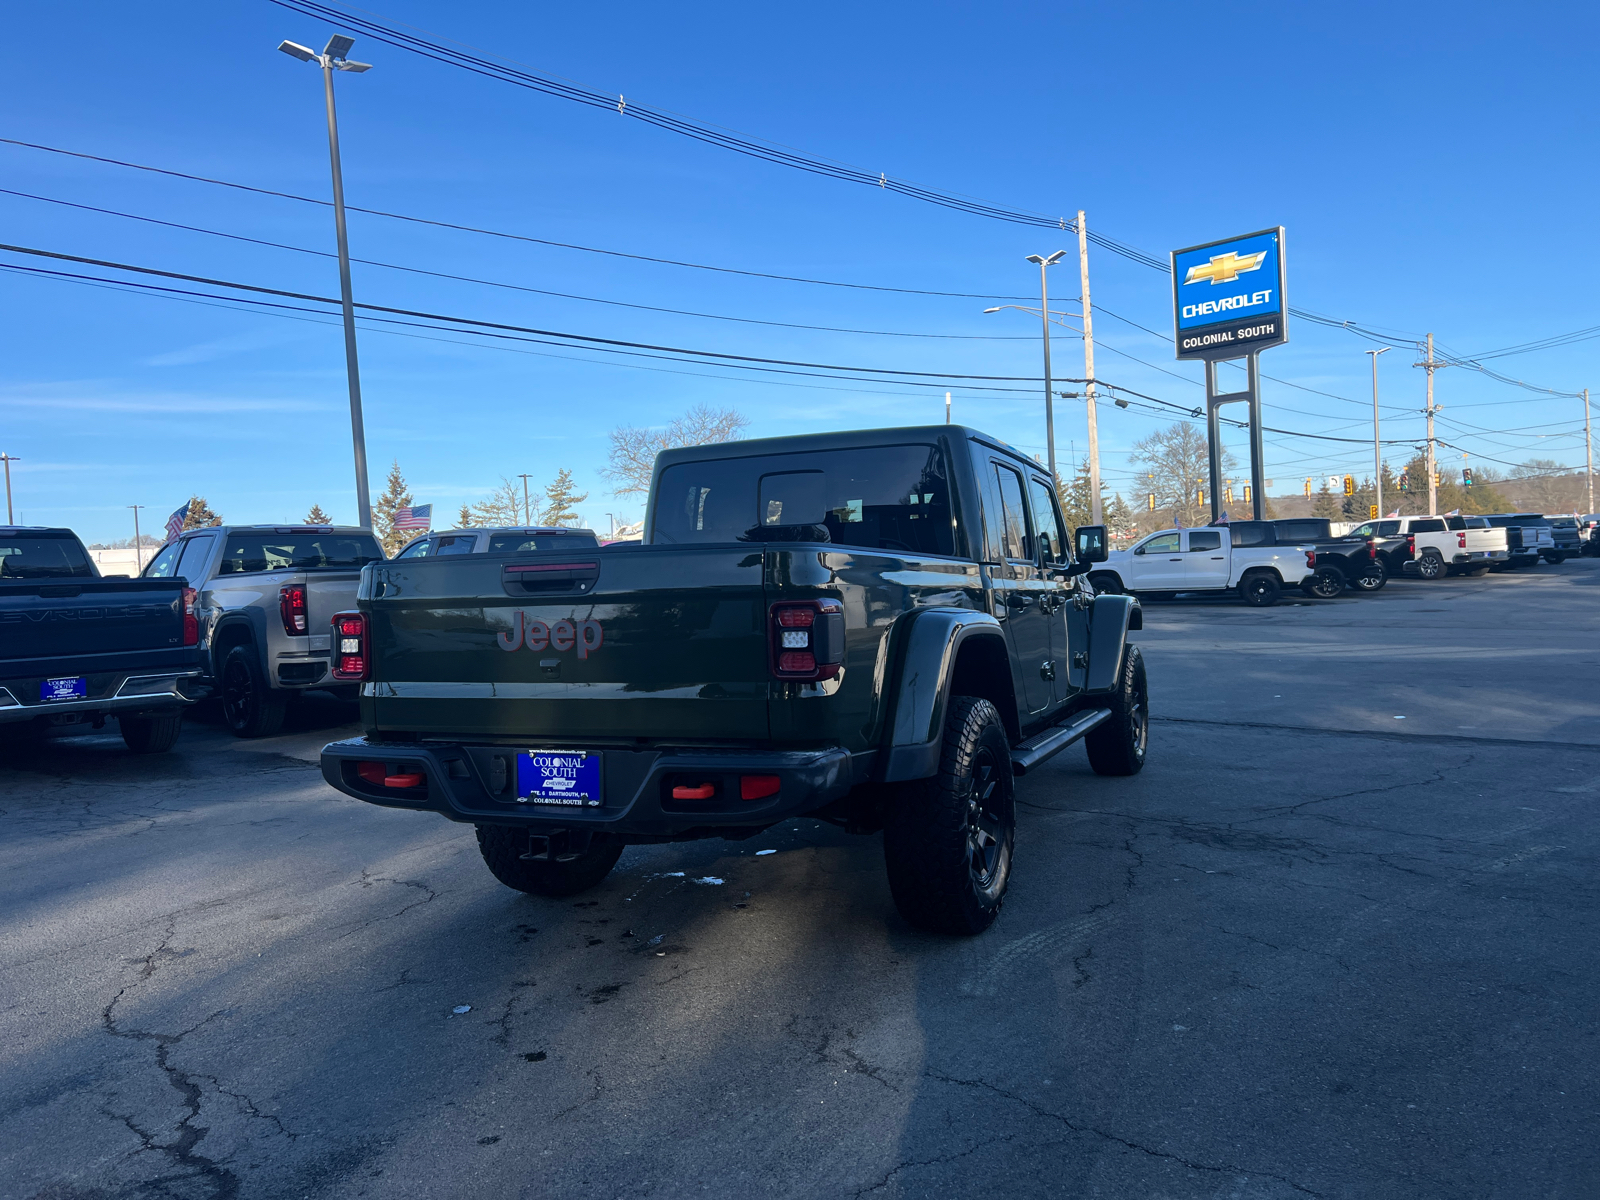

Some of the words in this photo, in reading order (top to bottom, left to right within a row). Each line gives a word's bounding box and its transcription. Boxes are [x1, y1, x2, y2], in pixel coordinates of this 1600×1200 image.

[1182, 289, 1273, 319] CHEVROLET
[1183, 331, 1234, 349] COLONIAL
[1238, 323, 1275, 339] SOUTH
[496, 611, 604, 660] Jeep
[533, 757, 584, 768] COLONIAL
[541, 767, 576, 777] SOUTH
